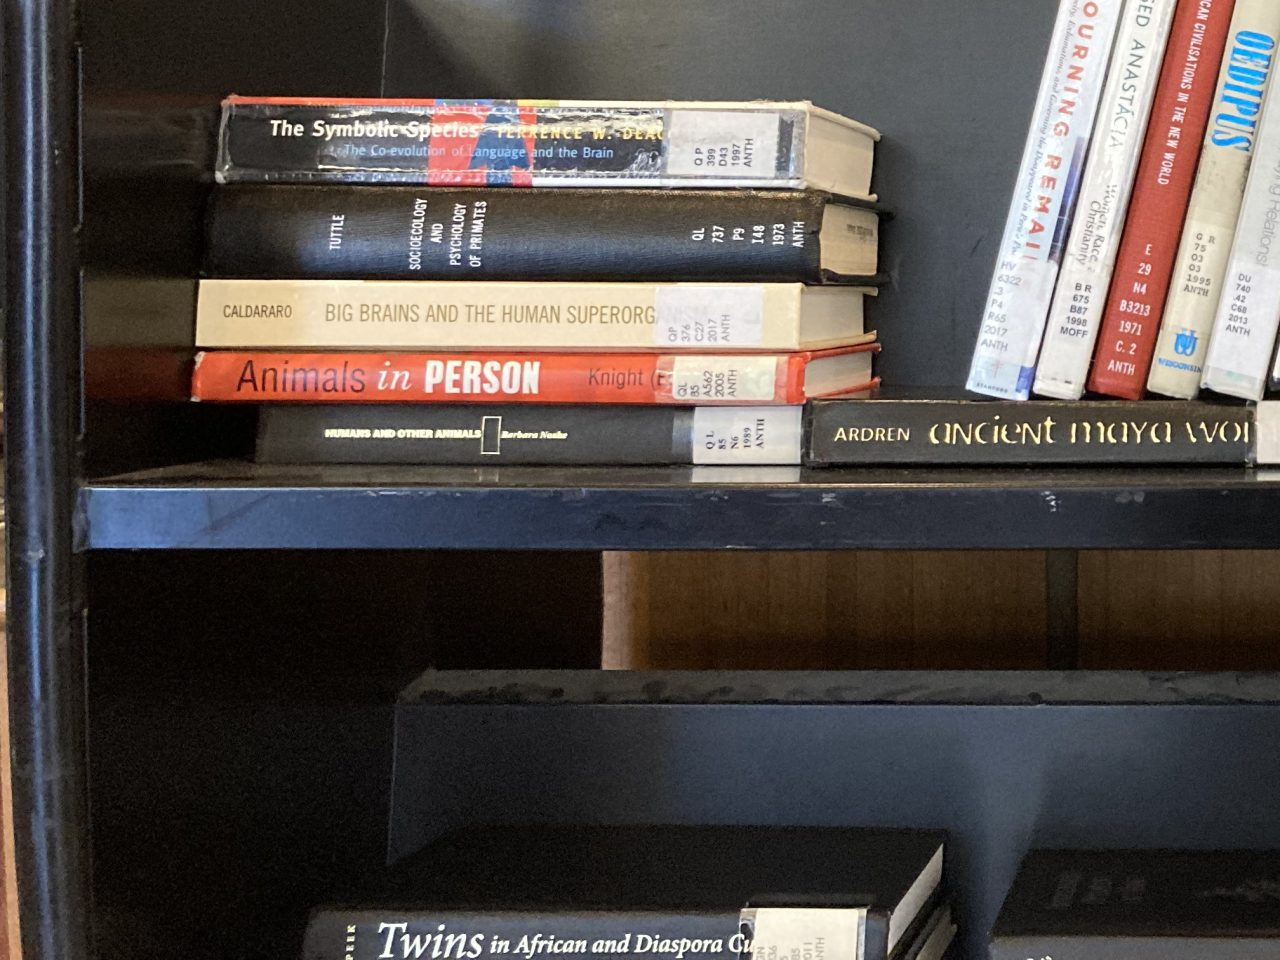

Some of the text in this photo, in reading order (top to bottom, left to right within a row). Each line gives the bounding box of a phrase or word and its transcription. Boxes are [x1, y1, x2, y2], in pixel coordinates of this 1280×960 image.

[1179, 20, 1207, 91] CIVILISATIONS
[1210, 29, 1277, 153] OEDIPUS
[269, 119, 480, 142] The Symbolic Species
[1168, 125, 1184, 150] NEW
[343, 143, 614, 161] The Co-evolution of Language and the Brain
[731, 143, 741, 168] 1997
[744, 136, 754, 169] ANTH
[1157, 150, 1179, 185] WORLD
[1022, 153, 1063, 261] REMAI
[329, 213, 345, 251] TUTTLE
[409, 197, 428, 271] SOCIOECOLOGY
[430, 222, 444, 245] AND
[449, 202, 468, 267] PSYCHOLOGY
[469, 200, 488, 268] OF PRIMATES
[771, 222, 786, 247] 1973
[792, 220, 806, 249] ANTH
[1137, 262, 1152, 277] 29
[1132, 281, 1148, 295] N4
[222, 303, 293, 320] CALDARARO
[324, 303, 657, 325] BIG BRAINS AND THE HUMAN SUPERORG
[1119, 299, 1151, 317] B3213
[720, 313, 731, 343] ANTH
[1118, 320, 1143, 337] 1971
[1225, 324, 1251, 337] ANTH
[980, 339, 1009, 352] ANTH
[236, 358, 541, 395] Animals in PERSON
[588, 368, 644, 391] Knight
[1107, 359, 1136, 376] ANTH
[726, 368, 738, 398] ANTH
[324, 428, 483, 440] HUMANS AND OTHER ANIMALS
[501, 430, 539, 440] Barbara
[755, 417, 766, 449] ANTH
[833, 427, 910, 442] ARDREN
[929, 414, 1173, 445] ancient maya
[377, 921, 723, 960] Twins in African and Diaspora
